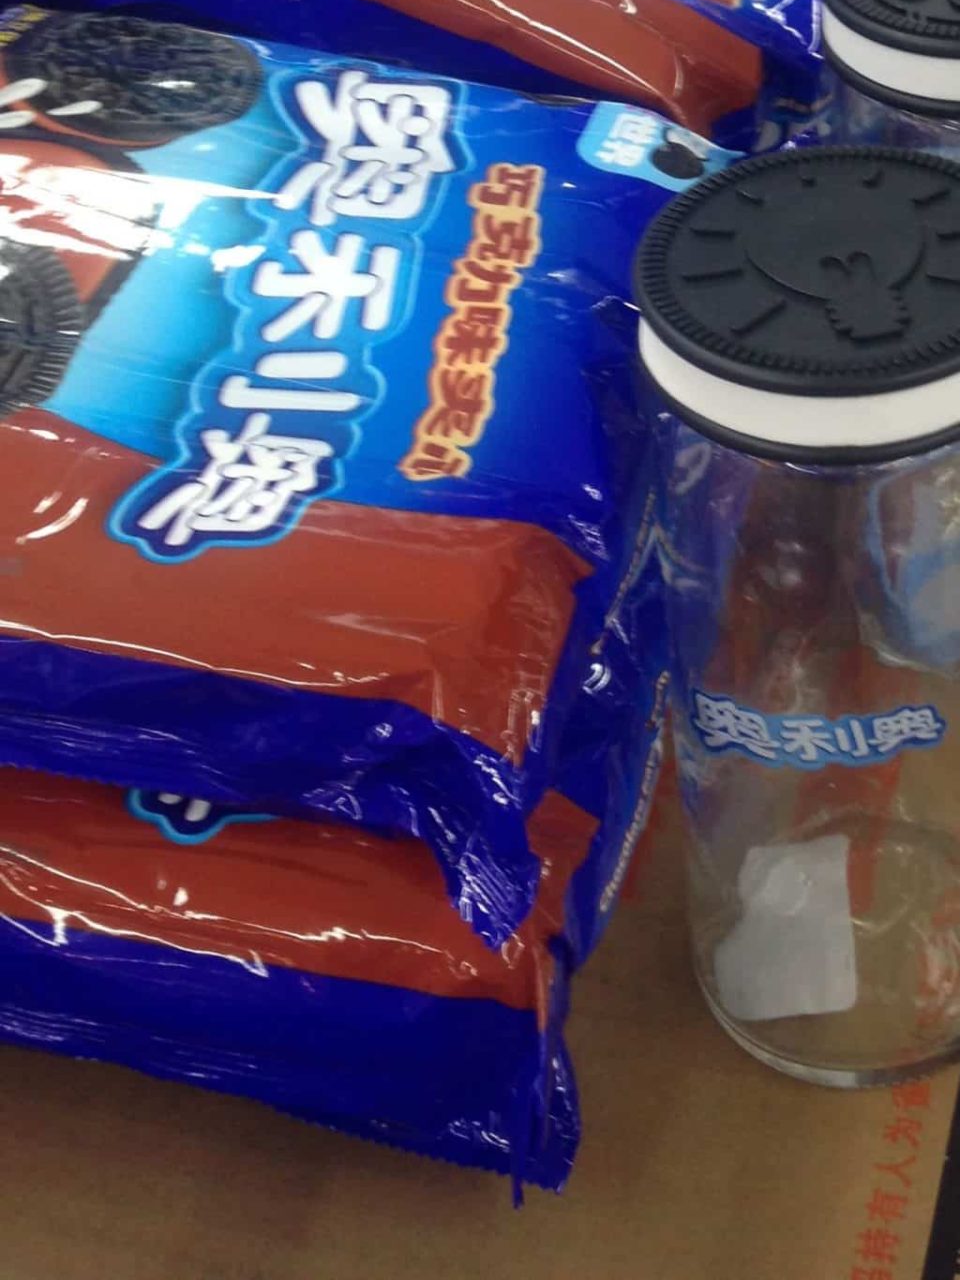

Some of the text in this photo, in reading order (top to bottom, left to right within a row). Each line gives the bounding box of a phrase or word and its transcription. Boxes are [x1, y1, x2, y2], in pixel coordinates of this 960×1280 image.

[139, 70, 455, 546] 奥利奥
[402, 163, 547, 480] 巧克力味夹心
[695, 692, 943, 763] 奥利奥
